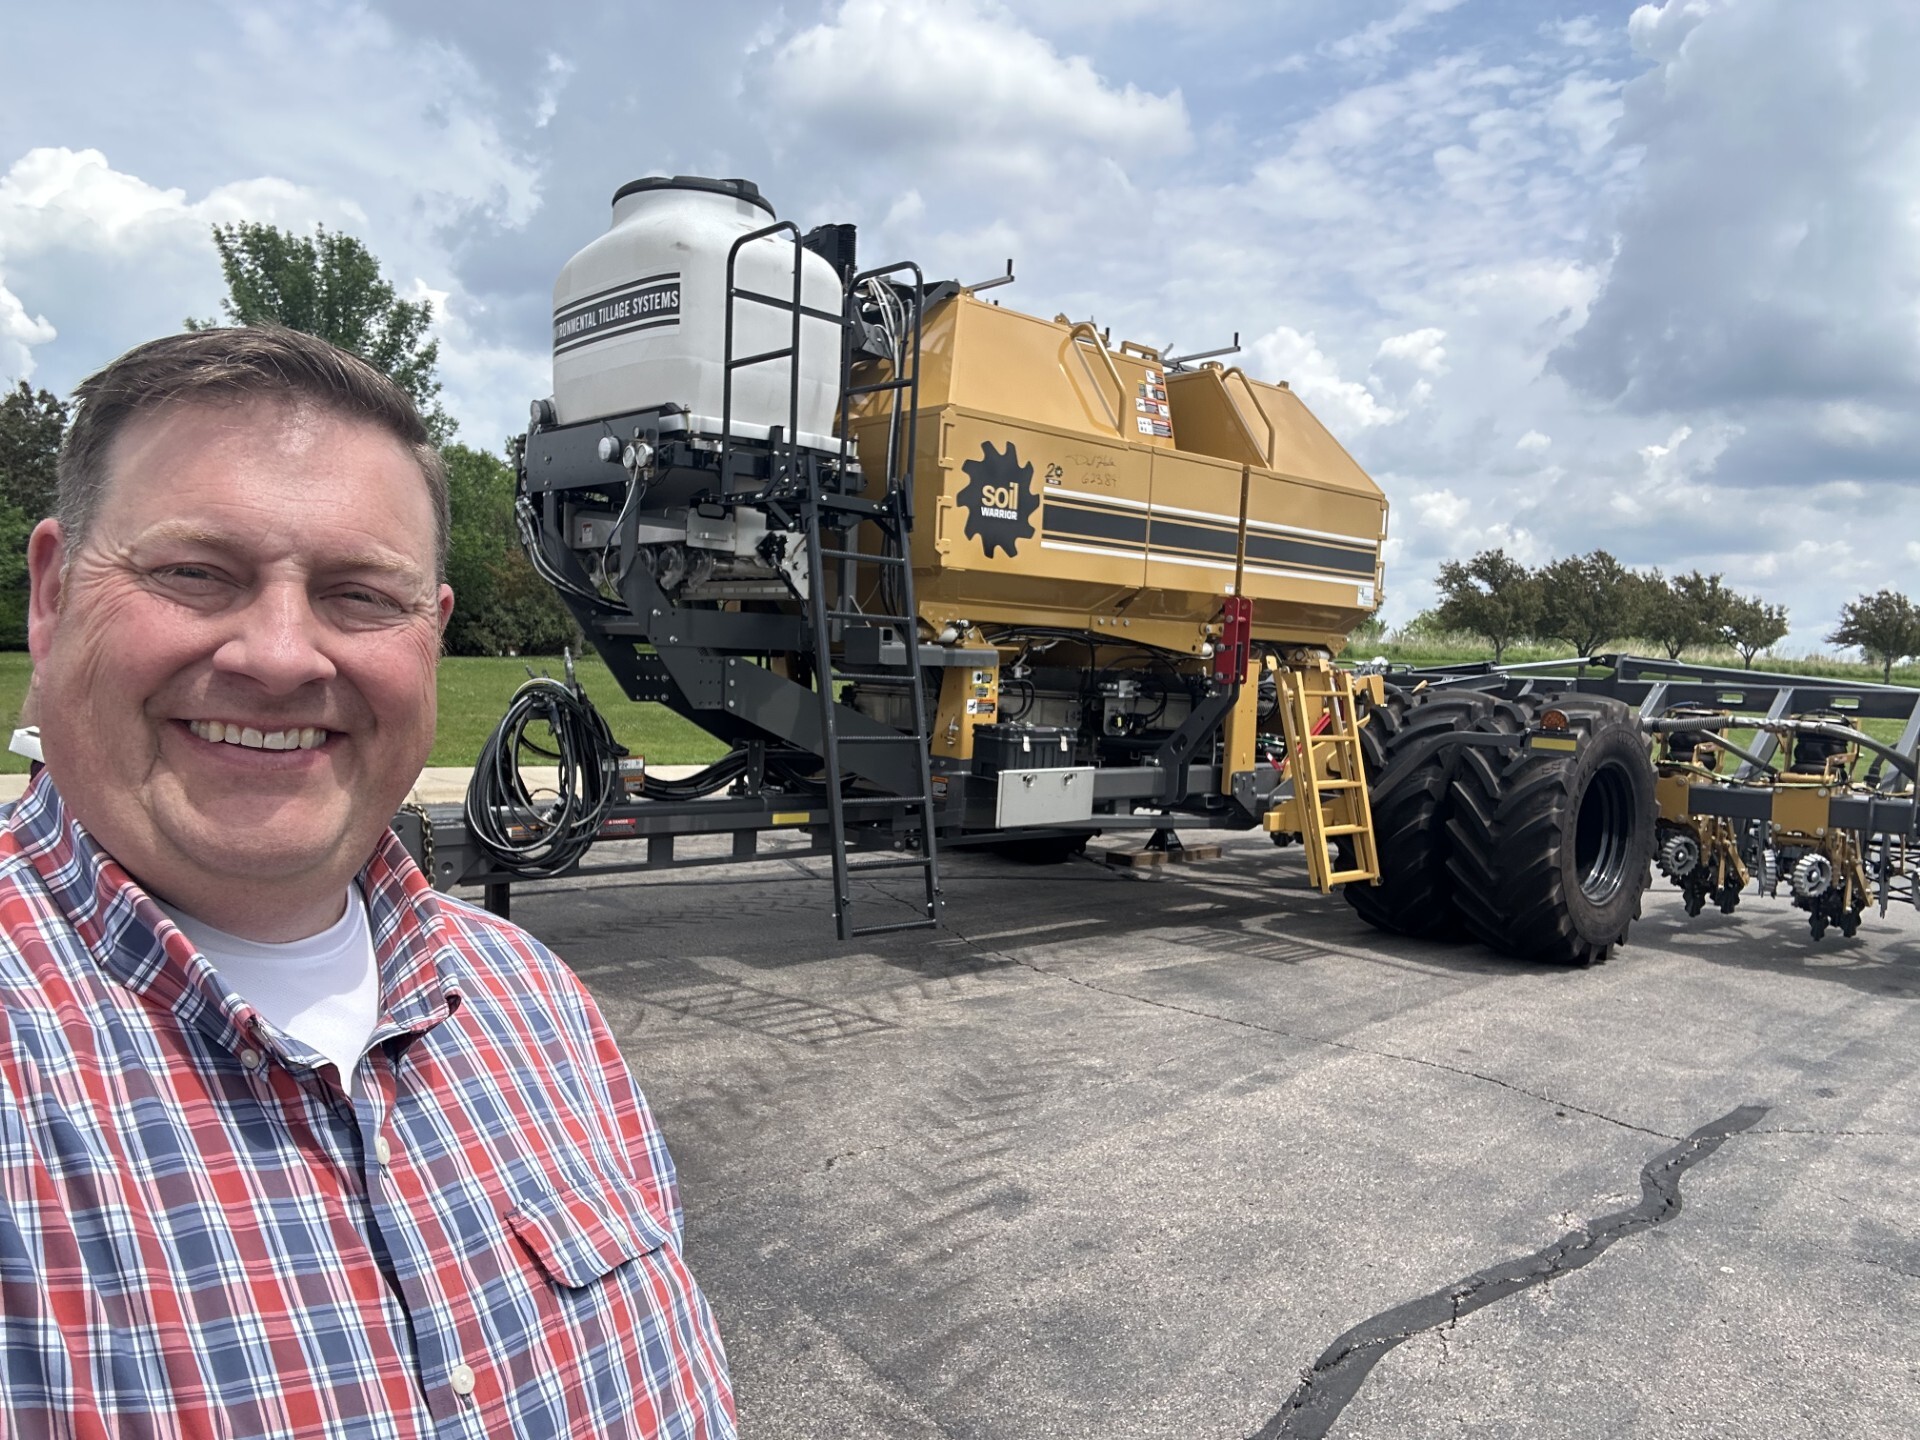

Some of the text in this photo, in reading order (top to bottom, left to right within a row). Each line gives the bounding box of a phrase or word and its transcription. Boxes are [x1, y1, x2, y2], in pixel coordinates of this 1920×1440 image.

[555, 290, 679, 338] RONMENTAL TILLAGE SYSTEMS
[981, 481, 1019, 510] soil
[980, 506, 1018, 521] WARRIOR
